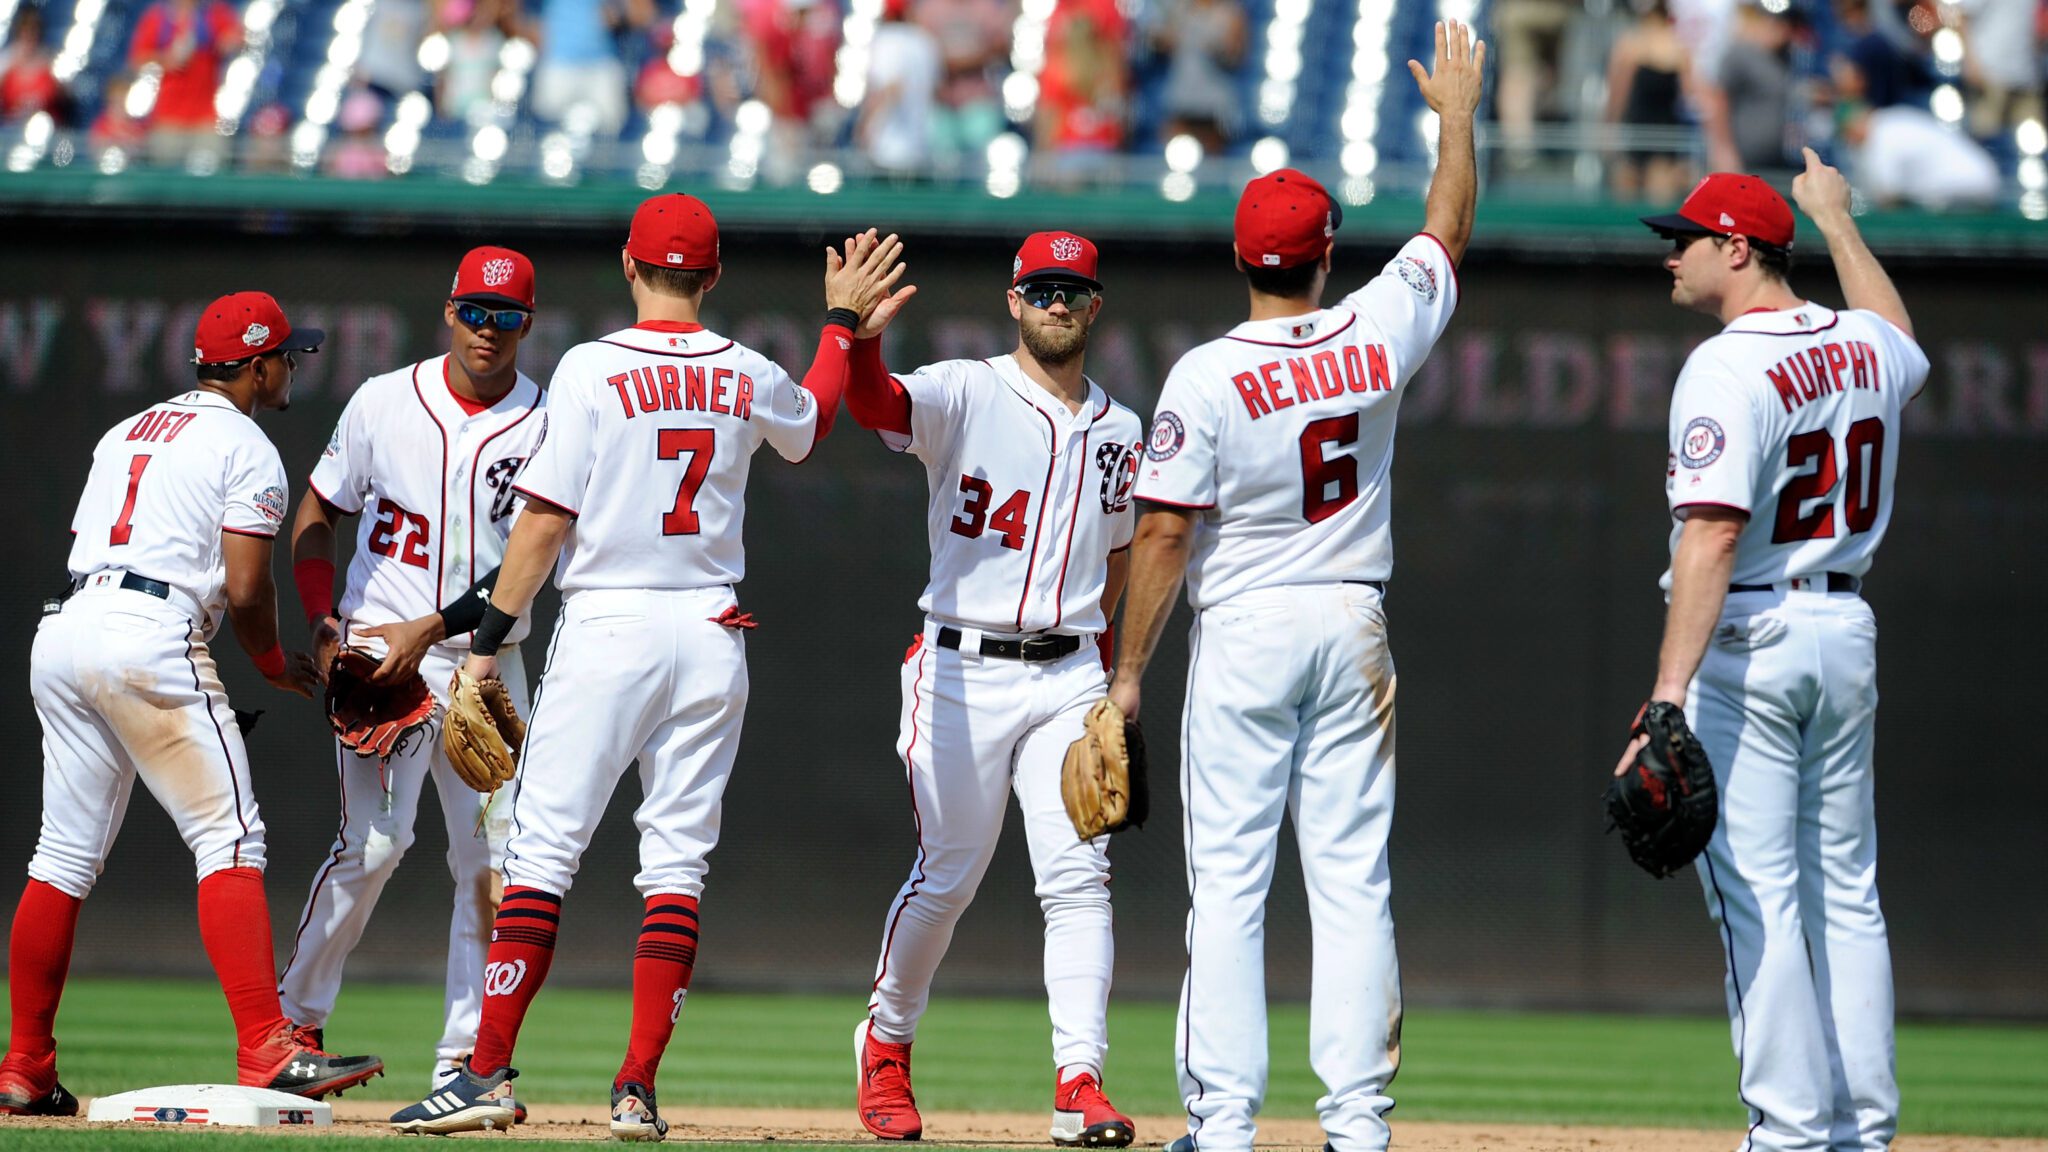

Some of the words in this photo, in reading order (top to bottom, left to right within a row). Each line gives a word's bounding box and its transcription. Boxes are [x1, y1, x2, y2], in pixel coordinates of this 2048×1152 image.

[607, 365, 755, 421] TURNER
[1231, 344, 1393, 420] RENDON
[1766, 340, 1881, 415] MURPHY
[126, 411, 197, 443] DIFO
[109, 454, 152, 547] 1
[657, 428, 715, 537] 7
[1298, 411, 1360, 525] 6
[1770, 416, 1885, 544] 20
[368, 498, 431, 570] 22
[950, 474, 1031, 551] 34
[484, 959, 527, 997] W
[626, 1098, 638, 1112] 7
